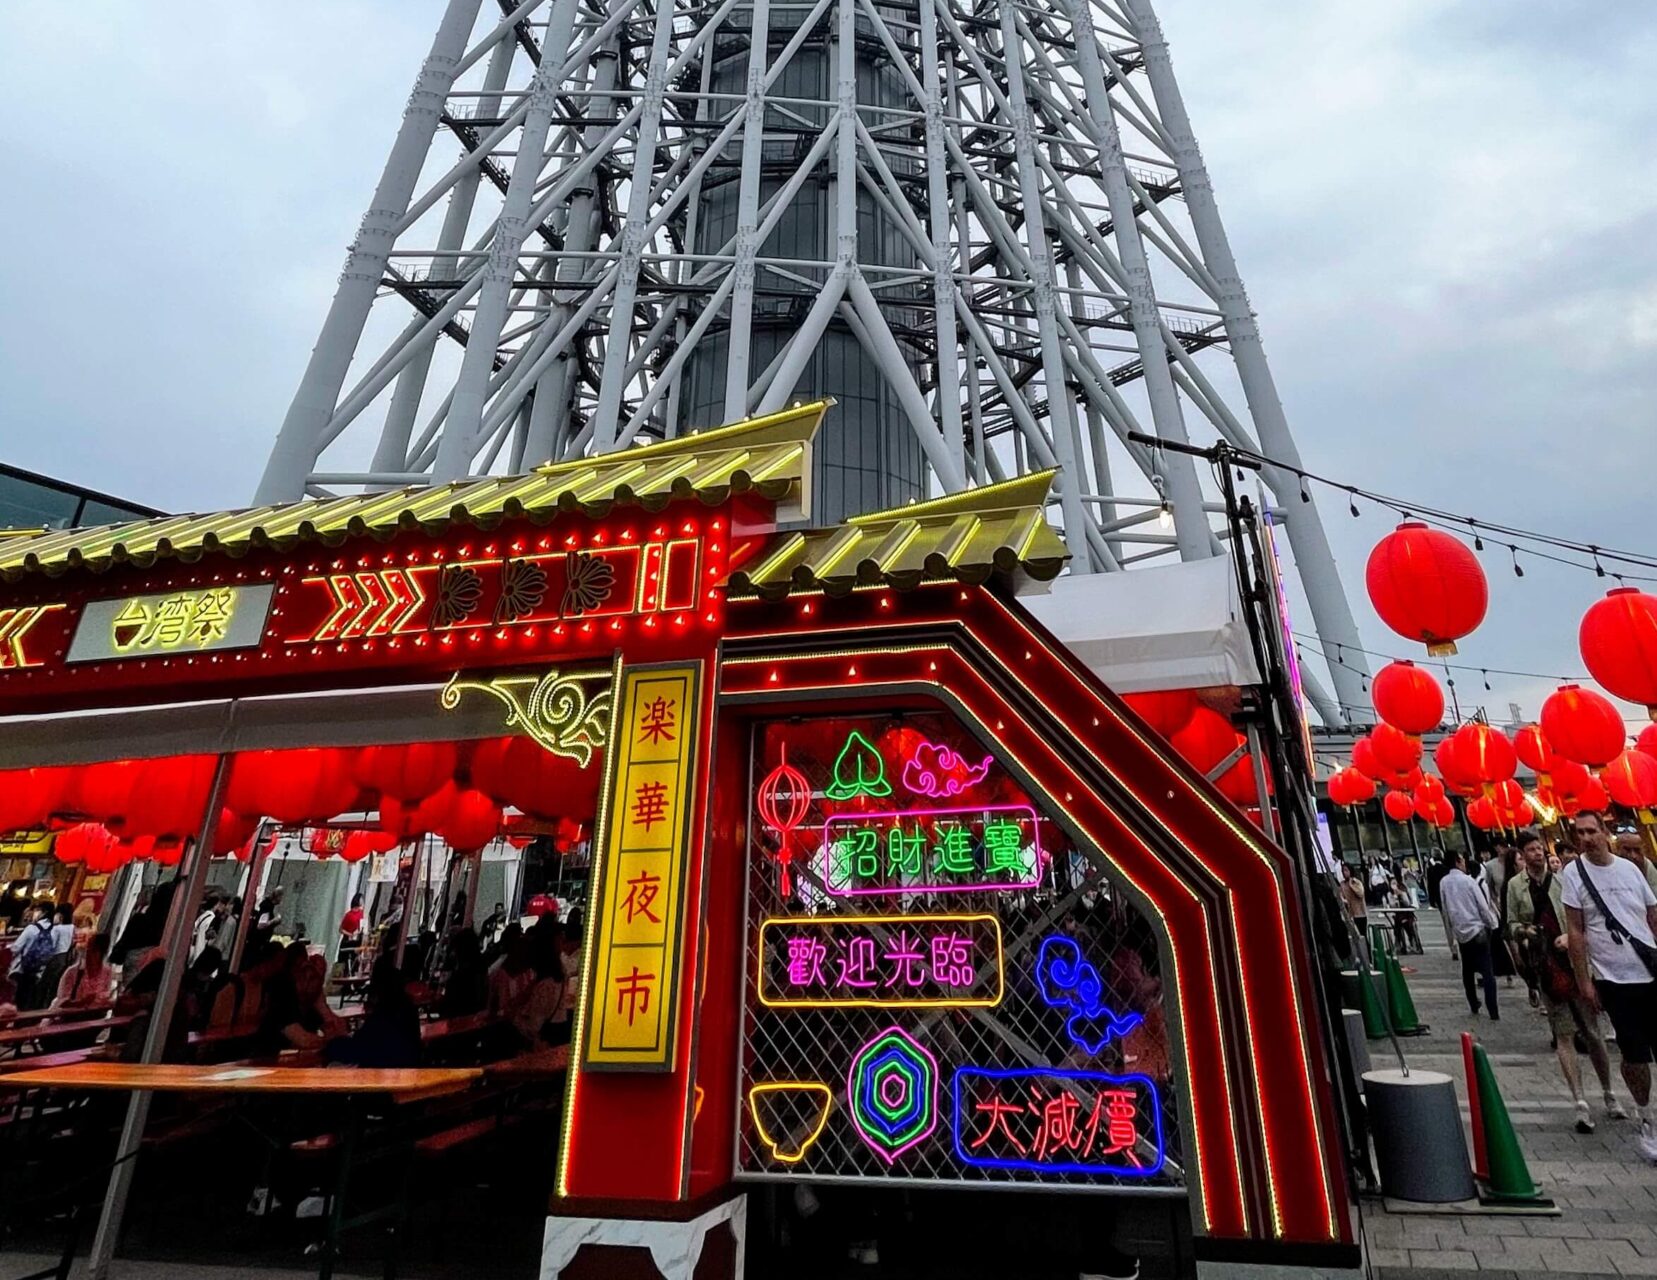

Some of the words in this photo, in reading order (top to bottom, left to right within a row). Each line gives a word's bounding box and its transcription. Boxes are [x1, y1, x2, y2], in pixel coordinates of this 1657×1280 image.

[113, 588, 234, 649] 台湾祭
[616, 696, 676, 1027] 楽華夜市
[836, 819, 1028, 877] 招財進寶
[787, 930, 974, 987] 歡迎光臨
[971, 1086, 1143, 1171] 大減價
